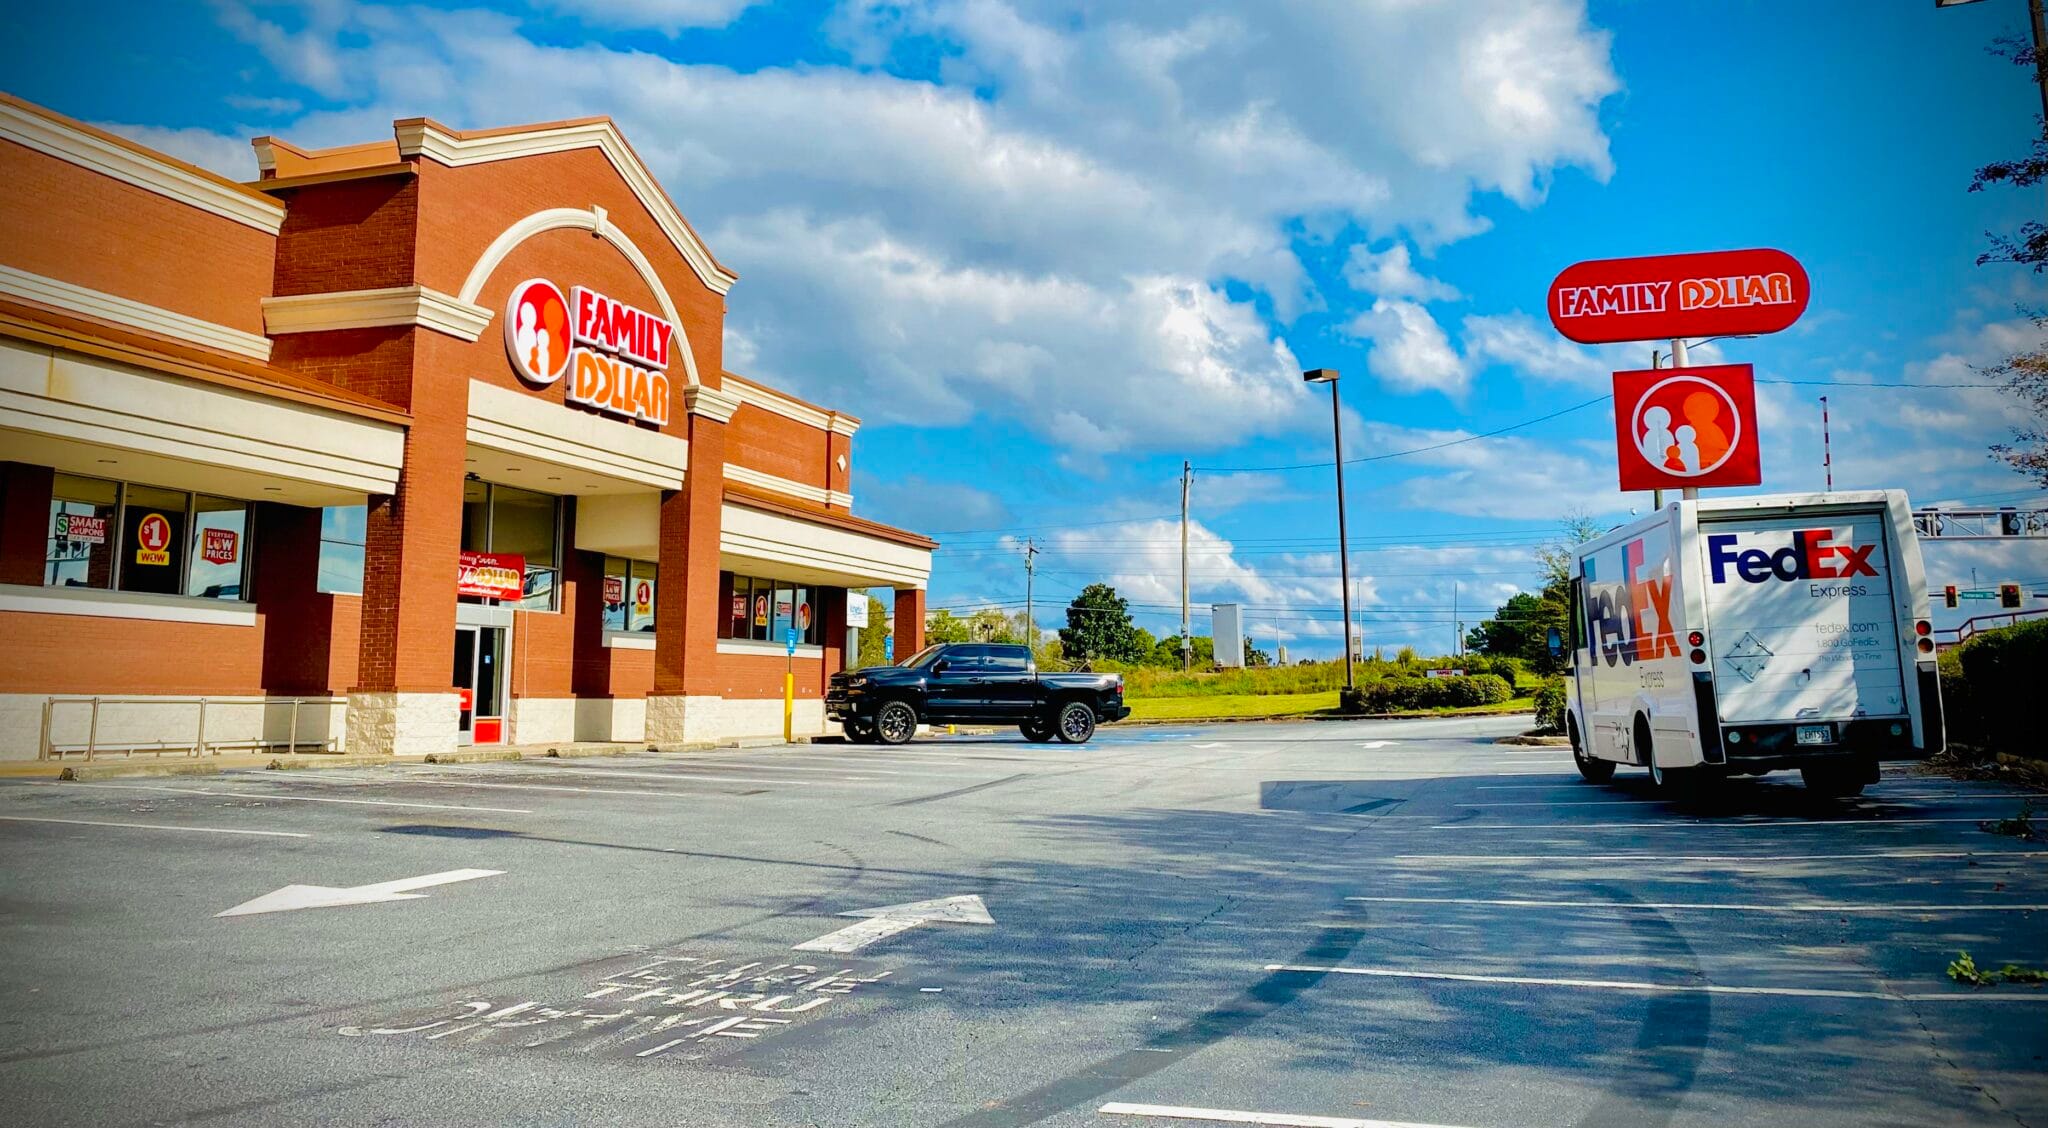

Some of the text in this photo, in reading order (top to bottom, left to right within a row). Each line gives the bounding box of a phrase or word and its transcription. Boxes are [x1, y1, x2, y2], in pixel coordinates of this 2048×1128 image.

[1559, 273, 1791, 317] FAMILY DOLLAR
[573, 287, 673, 368] FAMILY
[572, 348, 669, 424] DOLLAR
[70, 516, 105, 529] SMART
[143, 520, 161, 546] $1
[206, 538, 233, 550] LOW
[206, 551, 232, 560] PRICES
[1707, 529, 1880, 584] FedEx
[1584, 538, 1682, 668] FedEx
[1811, 584, 1867, 598] Express
[1816, 622, 1879, 634] fedex.com
[1640, 666, 1665, 688] Express
